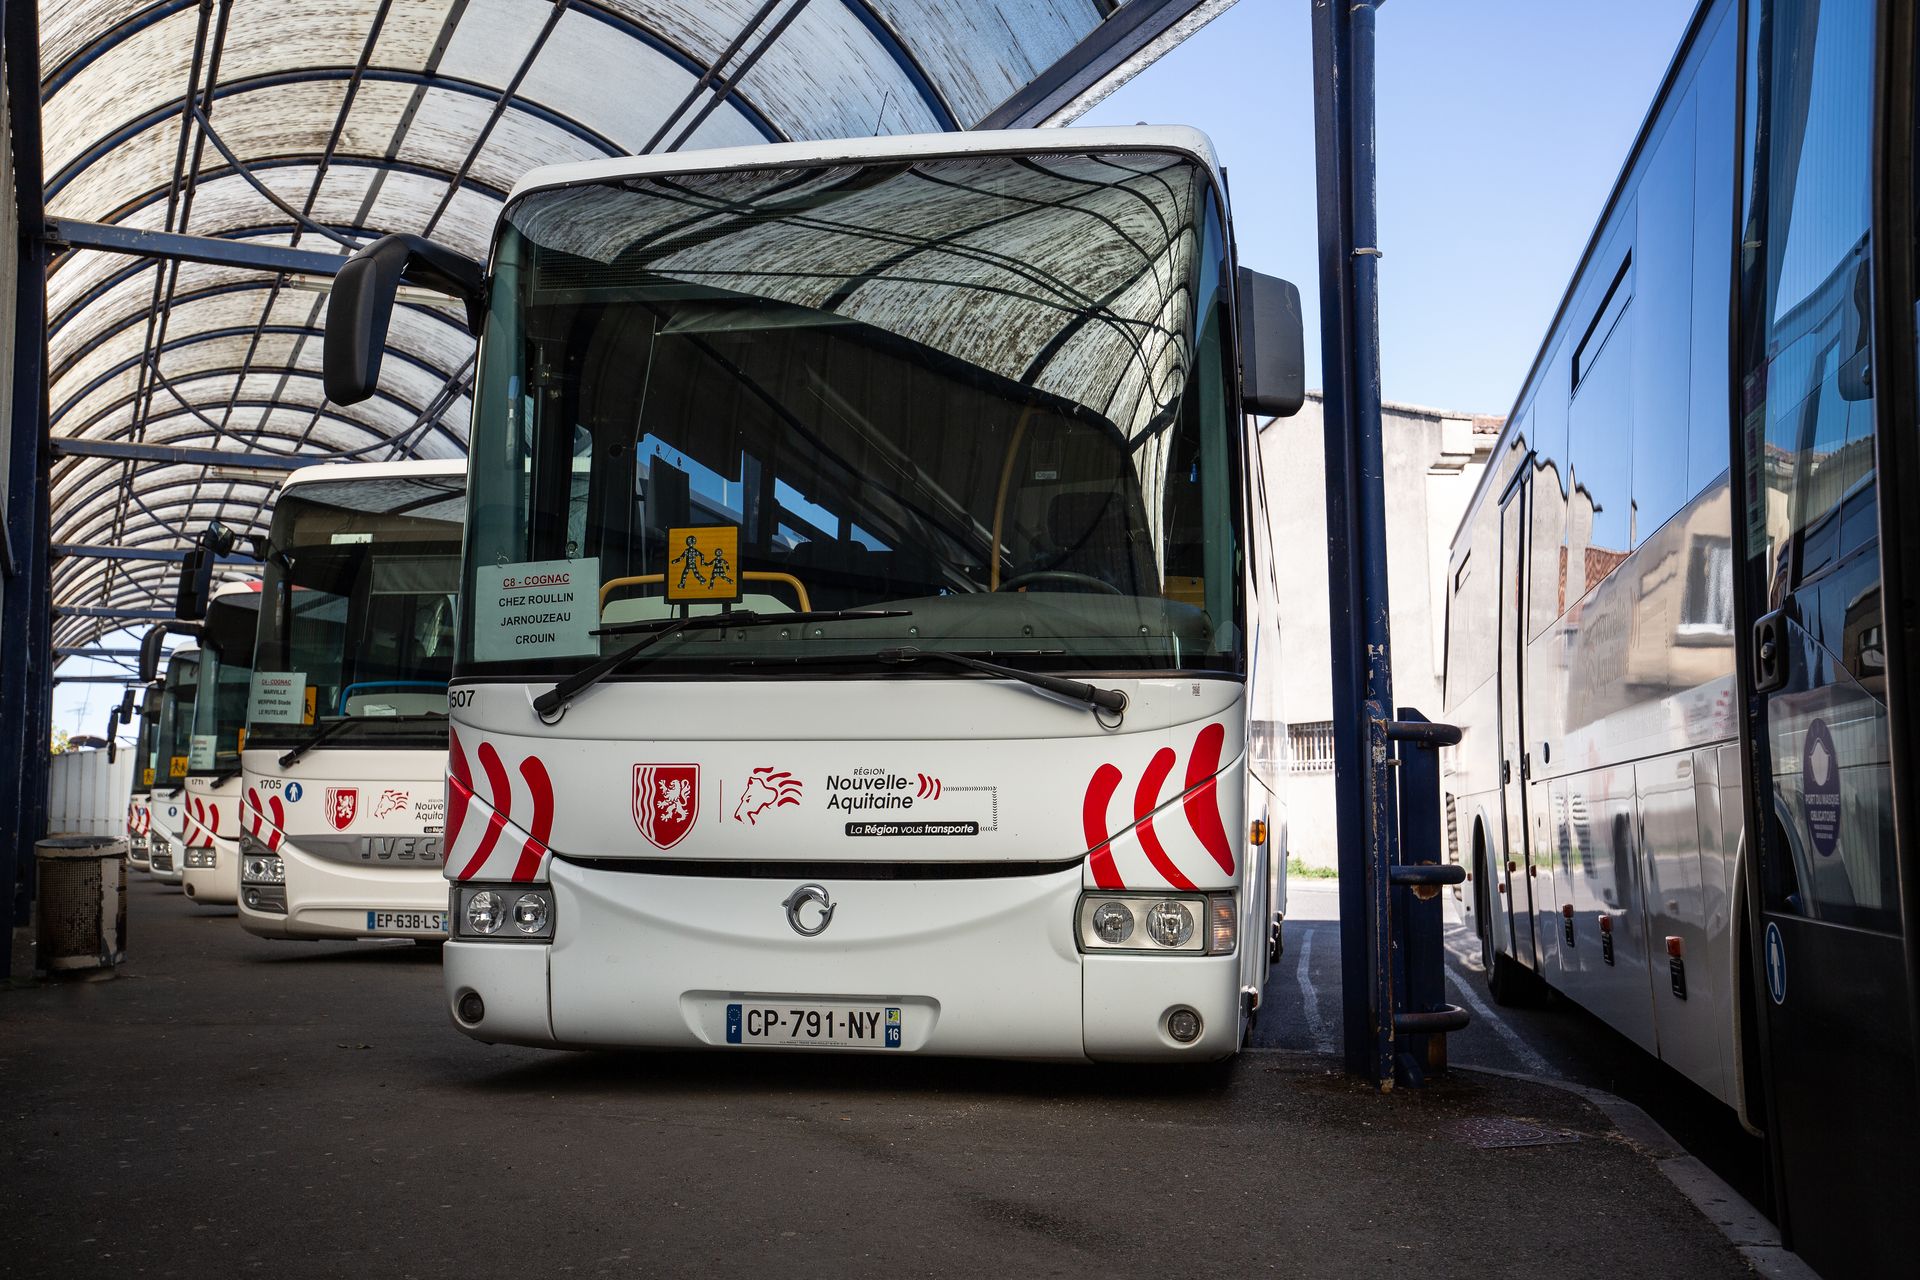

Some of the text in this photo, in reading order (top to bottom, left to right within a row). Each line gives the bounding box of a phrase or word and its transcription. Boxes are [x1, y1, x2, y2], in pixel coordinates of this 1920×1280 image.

[503, 577, 516, 588] C8
[524, 573, 570, 586] COGNAC
[498, 592, 574, 607] CHEZ ROULLIN
[500, 612, 571, 627] JARNOUZEAU
[515, 632, 556, 645] CROUIN
[853, 766, 886, 776] RÉGION
[259, 779, 282, 789] 1705
[826, 774, 915, 791] Nouvelle-
[826, 792, 914, 815] Aquitaine
[850, 824, 974, 836] La Région vous transporte
[361, 836, 444, 860] IVEC
[377, 913, 440, 929] EP-638-LS
[731, 1025, 737, 1033] F
[747, 1009, 881, 1039] CP-791-NY
[888, 1028, 899, 1041] 16
